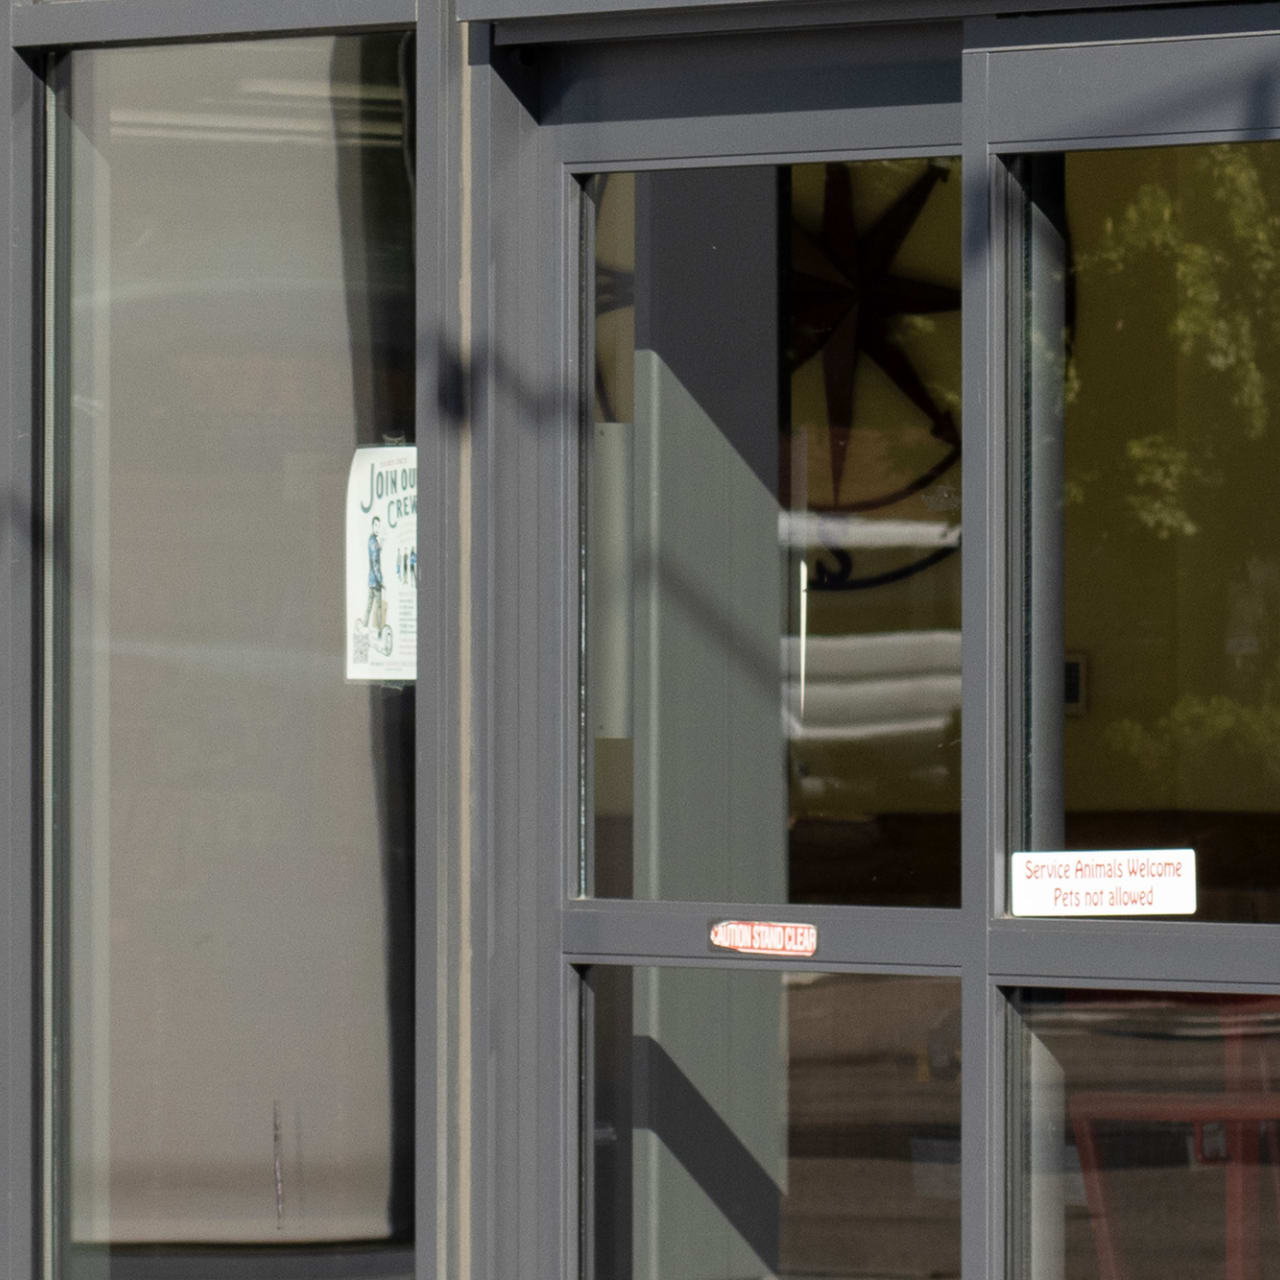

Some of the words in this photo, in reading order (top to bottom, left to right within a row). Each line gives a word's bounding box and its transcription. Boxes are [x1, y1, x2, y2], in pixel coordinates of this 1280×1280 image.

[1025, 860, 1070, 880] Service
[1074, 860, 1123, 880] Animals
[1127, 858, 1183, 878] Welcome
[1053, 887, 1080, 907] Pets
[1084, 888, 1104, 907] not
[1108, 886, 1154, 907] allowed
[784, 926, 816, 952] CLEAR
